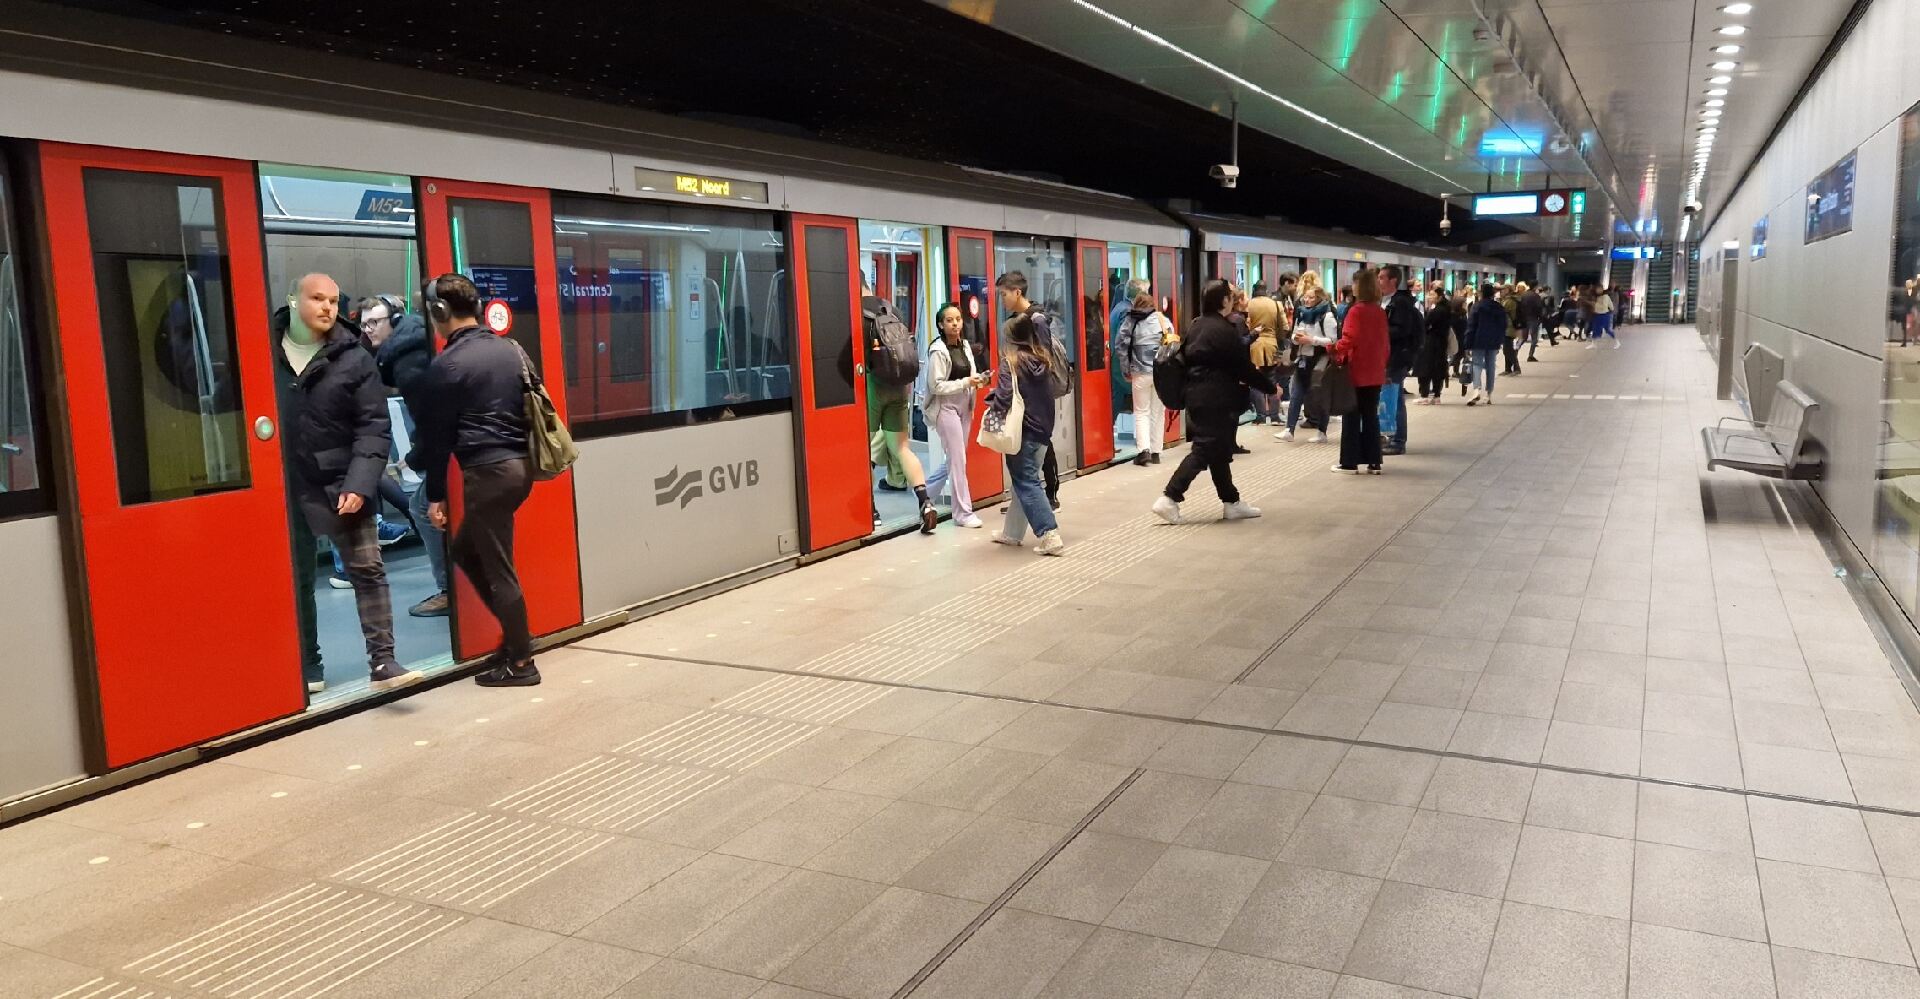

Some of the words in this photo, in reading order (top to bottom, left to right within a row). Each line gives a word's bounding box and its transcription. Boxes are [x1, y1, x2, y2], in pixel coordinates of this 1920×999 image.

[676, 176, 698, 192] M52
[702, 179, 730, 196] Noord
[367, 197, 404, 213] M52
[709, 459, 759, 493] GVB
